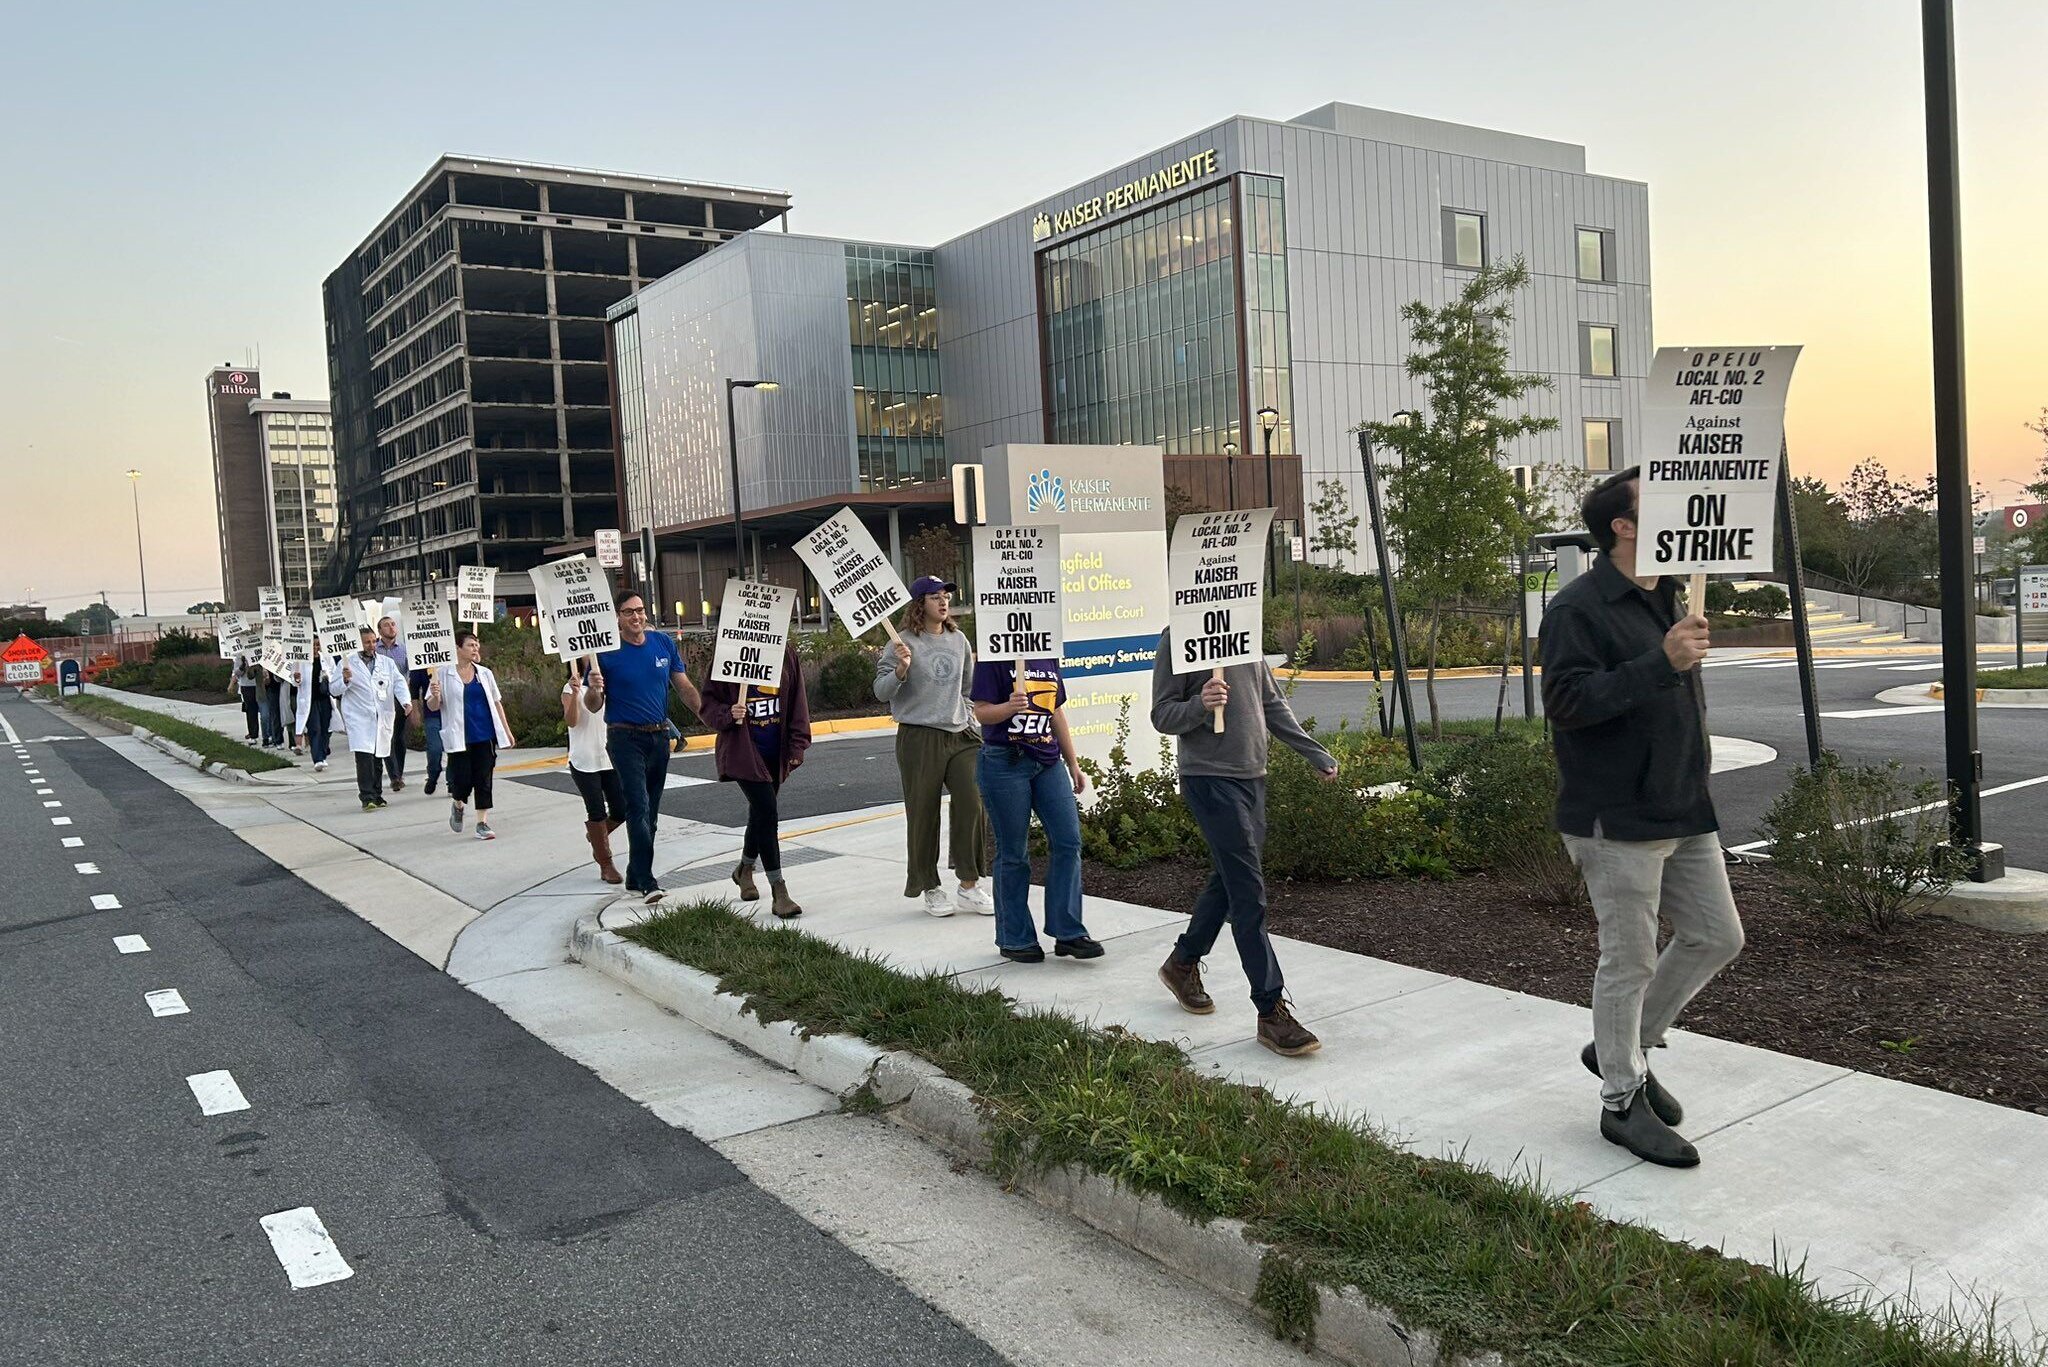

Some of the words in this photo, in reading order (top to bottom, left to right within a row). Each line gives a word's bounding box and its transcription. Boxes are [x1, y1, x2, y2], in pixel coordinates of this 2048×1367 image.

[1054, 198, 1102, 234] KAISER
[1106, 149, 1216, 212] PERMANENTE
[1676, 370, 1719, 386] LOCAL
[1724, 370, 1748, 386] NO.
[1754, 370, 1764, 385] 2
[221, 385, 258, 394] Hilton
[1690, 389, 1743, 404] AFL-CIO
[1685, 416, 1741, 430] Against
[1678, 434, 1744, 454] KAISER
[1649, 460, 1770, 481] PERMANENTE
[1070, 480, 1112, 494] KAISER
[1070, 496, 1152, 512] PERMANENTE
[1686, 494, 1726, 528] ON
[1192, 525, 1222, 538] LOCAL
[1224, 524, 1240, 534] NO.
[1244, 522, 1252, 532] 2
[812, 537, 832, 554] LOCAL
[830, 530, 844, 541] NO.
[842, 524, 850, 532] 2
[824, 536, 848, 558] AFL-CIO
[990, 540, 1016, 550] LOCAL
[1020, 539, 1034, 548] NO.
[1037, 539, 1042, 548] 2
[1201, 536, 1237, 549] AFL-CIO
[1655, 528, 1754, 563] STRIKE
[832, 548, 856, 566] Against
[1002, 550, 1032, 560] AFL-CIO
[1198, 554, 1236, 568] Against
[834, 553, 865, 580] KAISER
[1000, 566, 1034, 576] Against
[1060, 552, 1102, 575] ngfield
[554, 569, 574, 578] LOCAL
[565, 576, 588, 585] AFL-CIO
[829, 554, 884, 598] PERMANENTE
[1194, 566, 1238, 585] KAISER
[998, 576, 1037, 590] KAISER
[1062, 574, 1084, 592] ical
[1088, 574, 1132, 591] Offices
[566, 593, 596, 606] KAISER
[738, 590, 759, 600] LOCAL
[762, 593, 773, 602] NO.
[855, 581, 879, 604] ON
[980, 591, 1056, 606] PERMANENTE
[1176, 582, 1257, 606] PERMANENTE
[471, 602, 481, 610] ON
[557, 602, 610, 618] PERMANENTE
[744, 600, 770, 610] AFL-CIO
[852, 586, 901, 628] STRIKE
[1068, 605, 1112, 622] Loisdale
[1114, 604, 1144, 620] Court
[463, 610, 488, 619] STRIKE
[742, 610, 770, 620] Against
[1007, 612, 1032, 632] ON
[1204, 609, 1230, 636] ON
[416, 622, 440, 631] KAISER
[578, 618, 598, 635] ON
[738, 618, 770, 632] KAISER
[334, 633, 347, 643] ON
[407, 629, 451, 640] PERMANENTE
[568, 632, 613, 652] STRIKE
[722, 628, 782, 645] PERMANENTE
[327, 640, 357, 653] STRIKE
[424, 642, 439, 653] ON
[989, 632, 1052, 654] STRIKE
[1184, 631, 1250, 664] STRIKE
[415, 651, 451, 665] STRIKE
[740, 646, 761, 663] ON
[1059, 654, 1115, 670] Emergency
[8, 671, 40, 679] CLOSED
[722, 660, 773, 681] STRIKE
[1009, 670, 1045, 679] Vginia
[1070, 720, 1114, 736] eceiving
